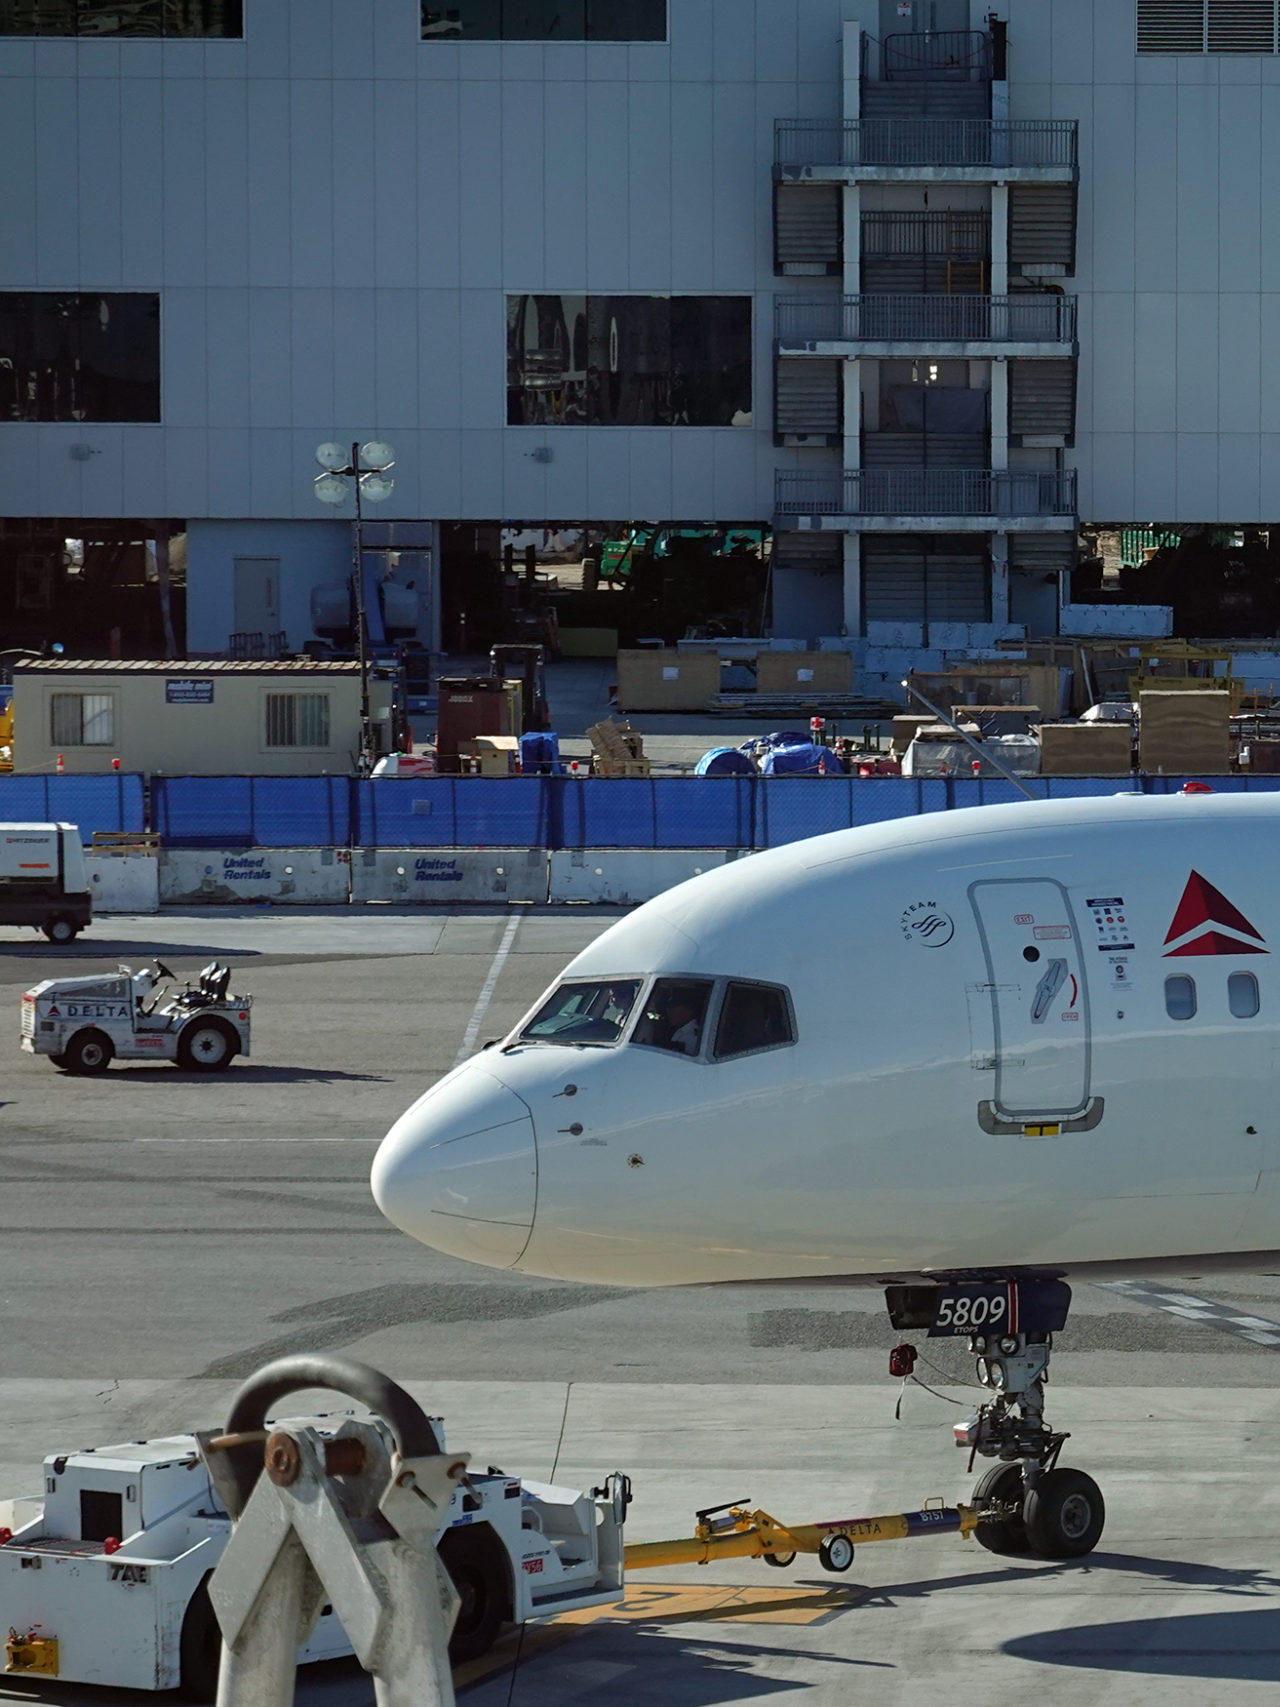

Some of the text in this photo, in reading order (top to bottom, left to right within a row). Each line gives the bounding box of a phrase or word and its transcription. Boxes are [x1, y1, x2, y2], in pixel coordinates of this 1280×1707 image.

[222, 857, 265, 869] United
[414, 858, 457, 870] United
[223, 868, 271, 880] Rentals
[414, 869, 463, 882] Rentals
[900, 900, 937, 941] SKYTEAM
[67, 1005, 128, 1018] DELTA
[935, 1295, 1006, 1327] 5809
[953, 1325, 979, 1334] ETOPS
[919, 1510, 945, 1522] B757
[839, 1523, 882, 1537] DELTA
